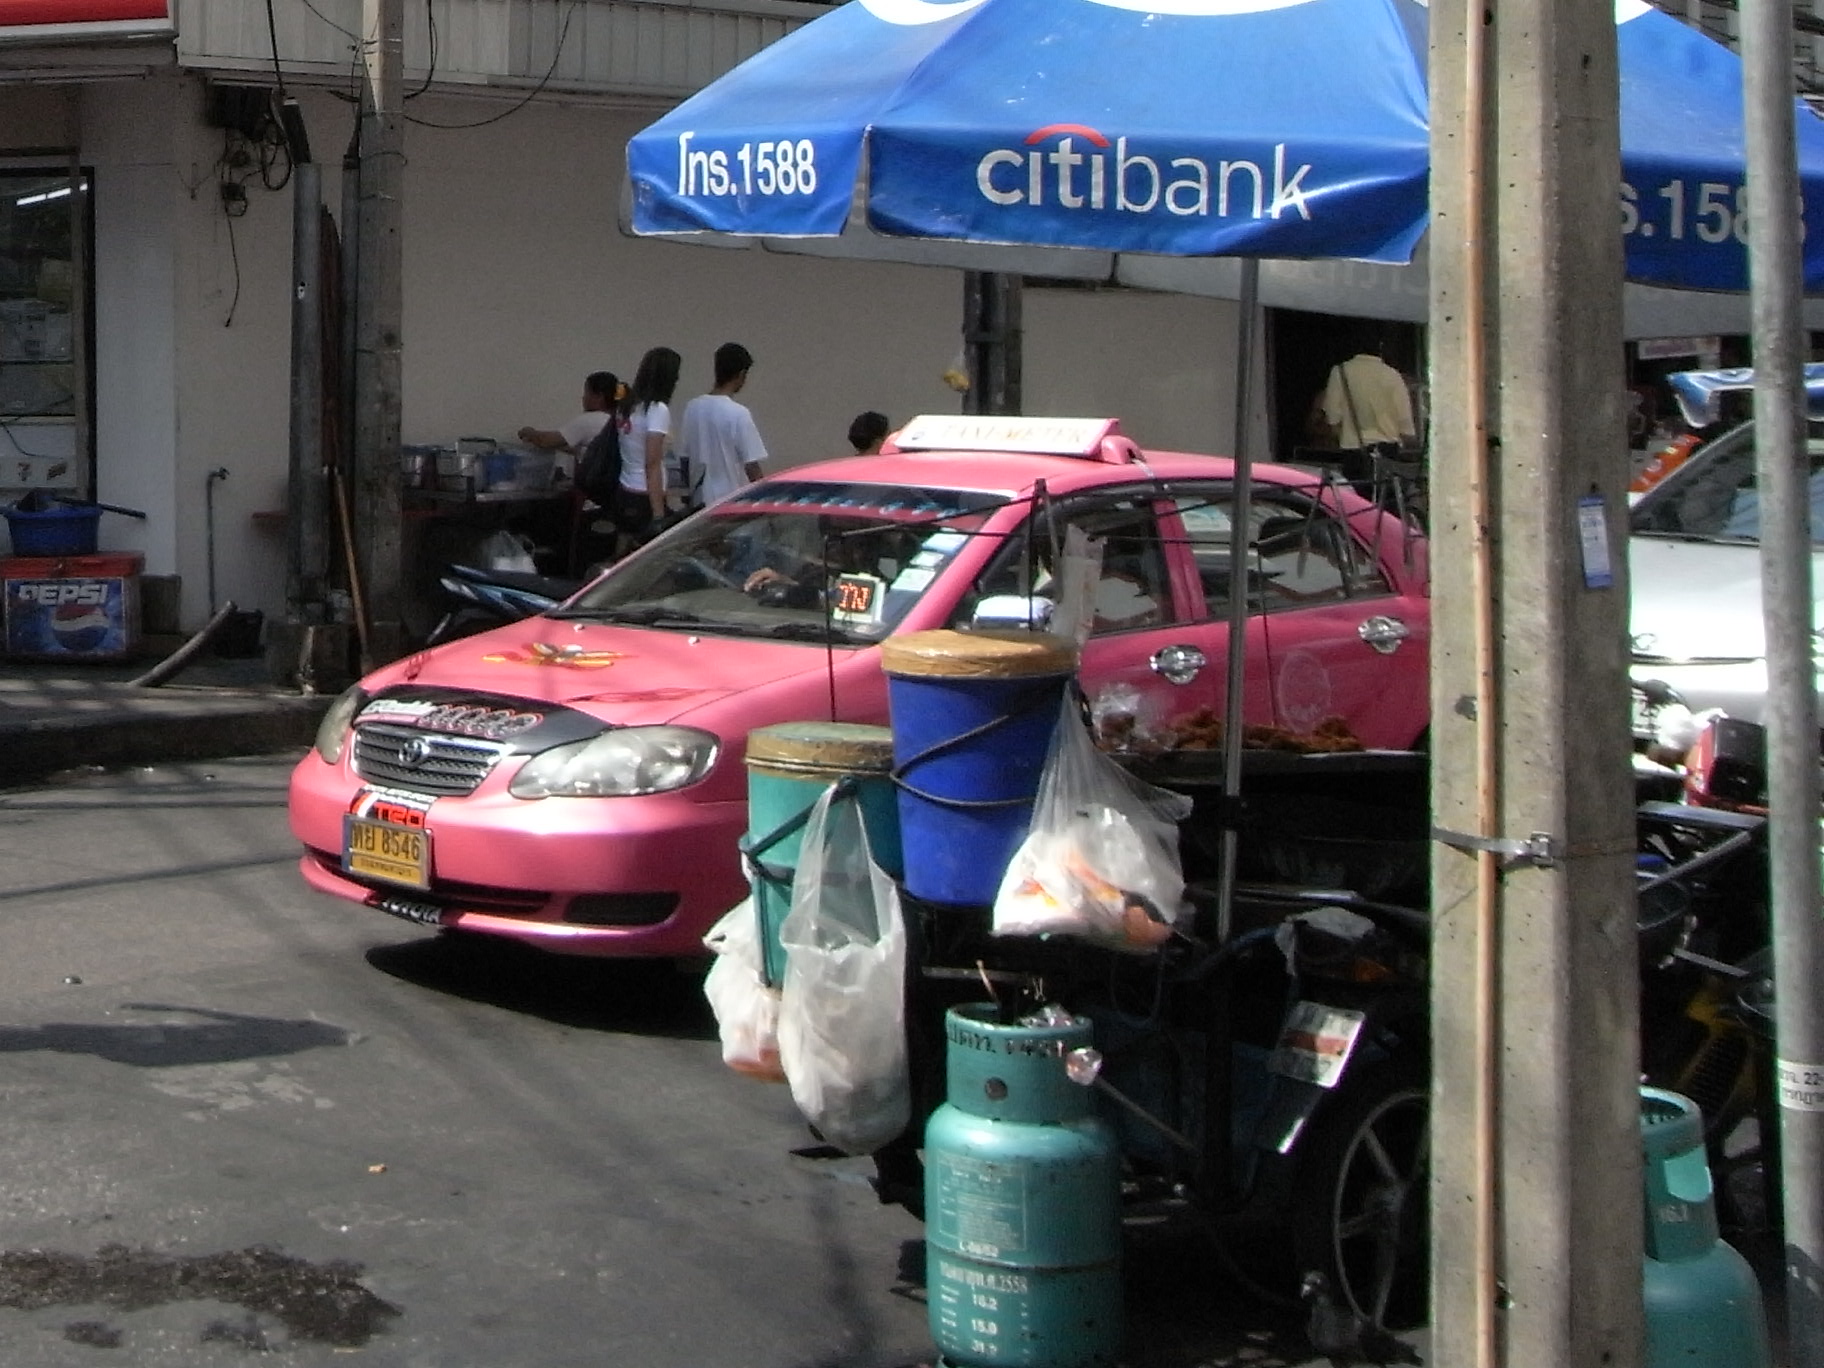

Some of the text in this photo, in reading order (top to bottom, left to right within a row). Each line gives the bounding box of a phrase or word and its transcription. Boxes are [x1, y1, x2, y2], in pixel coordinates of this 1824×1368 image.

[977, 126, 1312, 221] citibank
[17, 581, 109, 607] PEPSI
[382, 826, 421, 861] 8546
